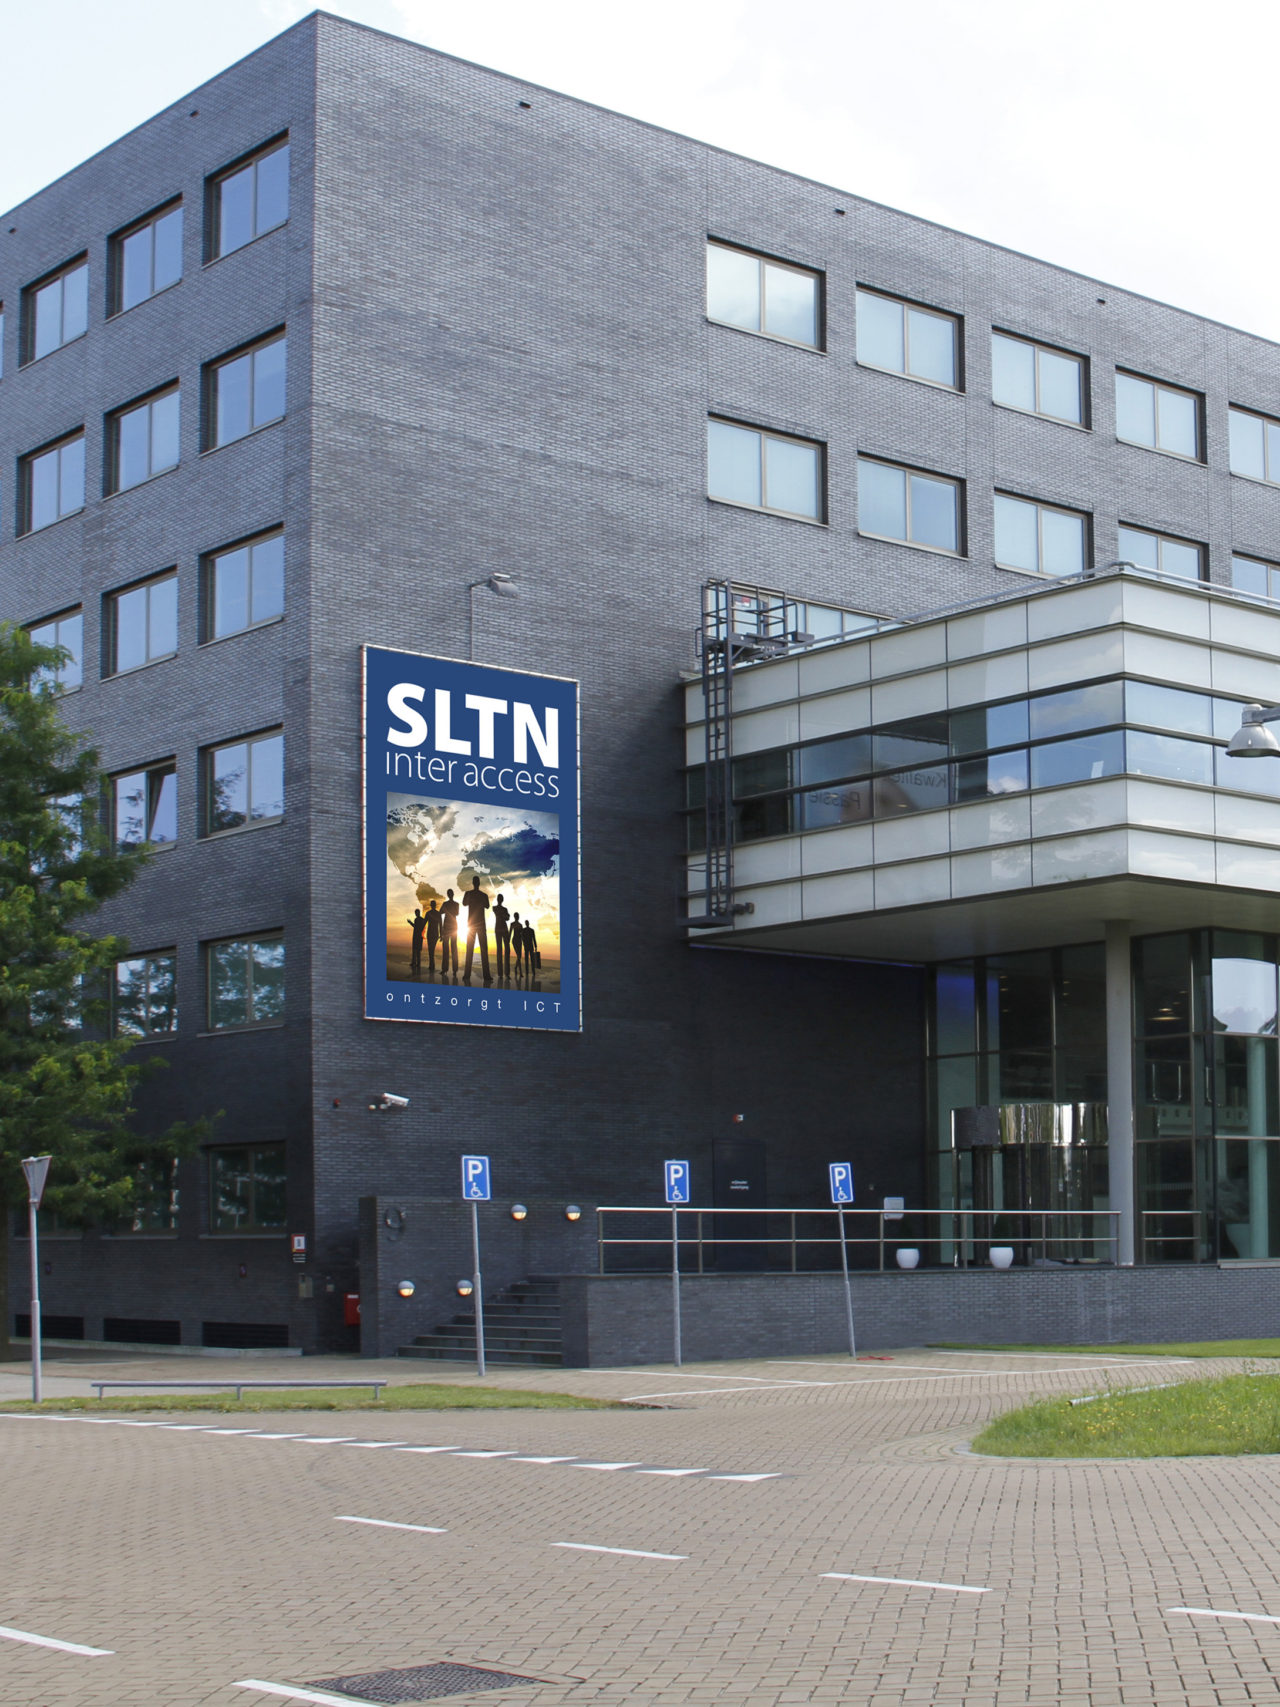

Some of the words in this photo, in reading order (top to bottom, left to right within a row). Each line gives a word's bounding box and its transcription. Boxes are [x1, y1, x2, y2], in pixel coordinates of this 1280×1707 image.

[386, 682, 560, 769] SLTN
[386, 992, 502, 1011] ontzorgt
[523, 1000, 561, 1013] ICT
[468, 1160, 483, 1182] P
[670, 1165, 683, 1186] P
[834, 1167, 846, 1187] P
